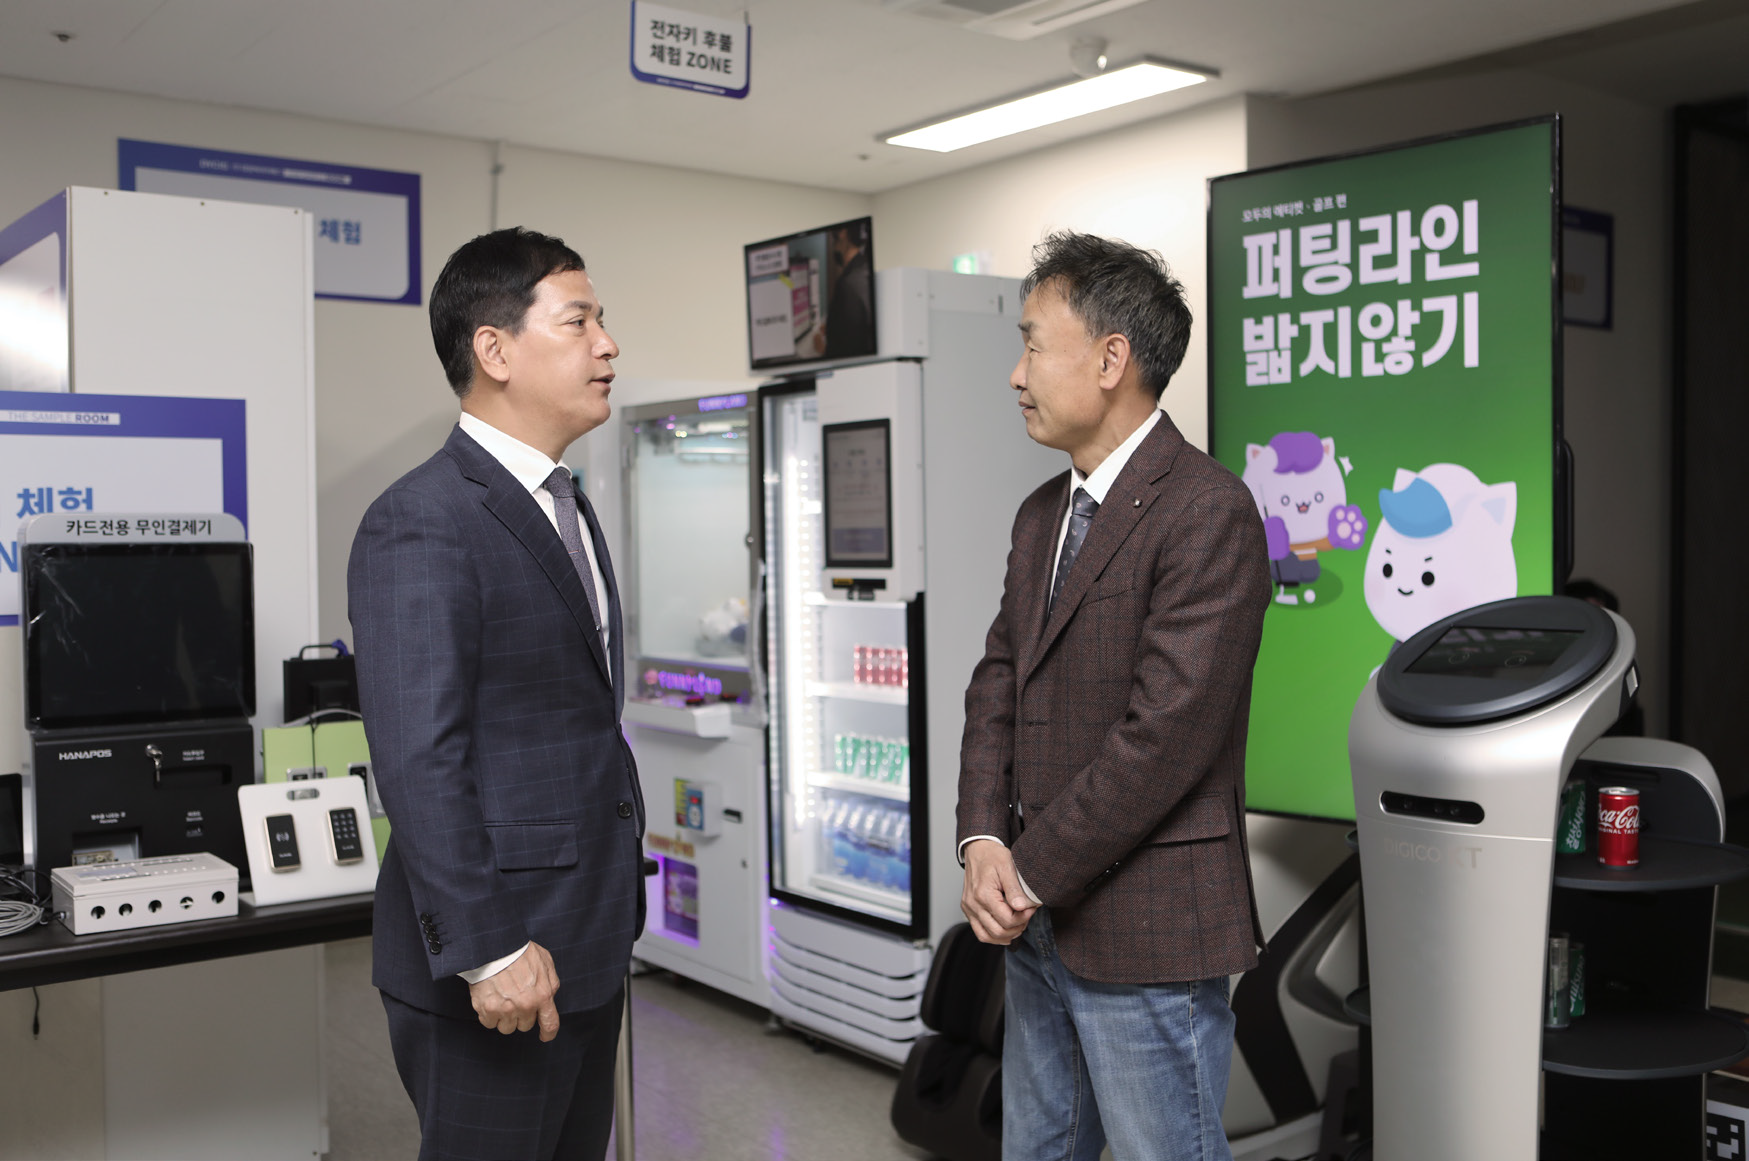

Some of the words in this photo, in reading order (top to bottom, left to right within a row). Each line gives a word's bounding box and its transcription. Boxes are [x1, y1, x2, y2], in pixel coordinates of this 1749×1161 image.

[650, 20, 697, 46] 전자키
[703, 31, 732, 53] 후불
[650, 44, 681, 67] 체험
[686, 52, 732, 75] ZONE
[1242, 206, 1272, 222] 모두의
[1273, 200, 1304, 217] 에티켓
[1313, 197, 1334, 213] 골프
[318, 219, 361, 245] 체험
[1243, 199, 1480, 299] 퍼팅라인
[1243, 291, 1480, 387] 밟지않기
[75, 413, 110, 424] ROOM
[66, 519, 131, 536] 카드전용
[135, 519, 212, 536] 무인결제기
[58, 749, 112, 761] HANAPOS
[1383, 837, 1441, 862] DIGICO
[1447, 847, 1483, 869] KT
